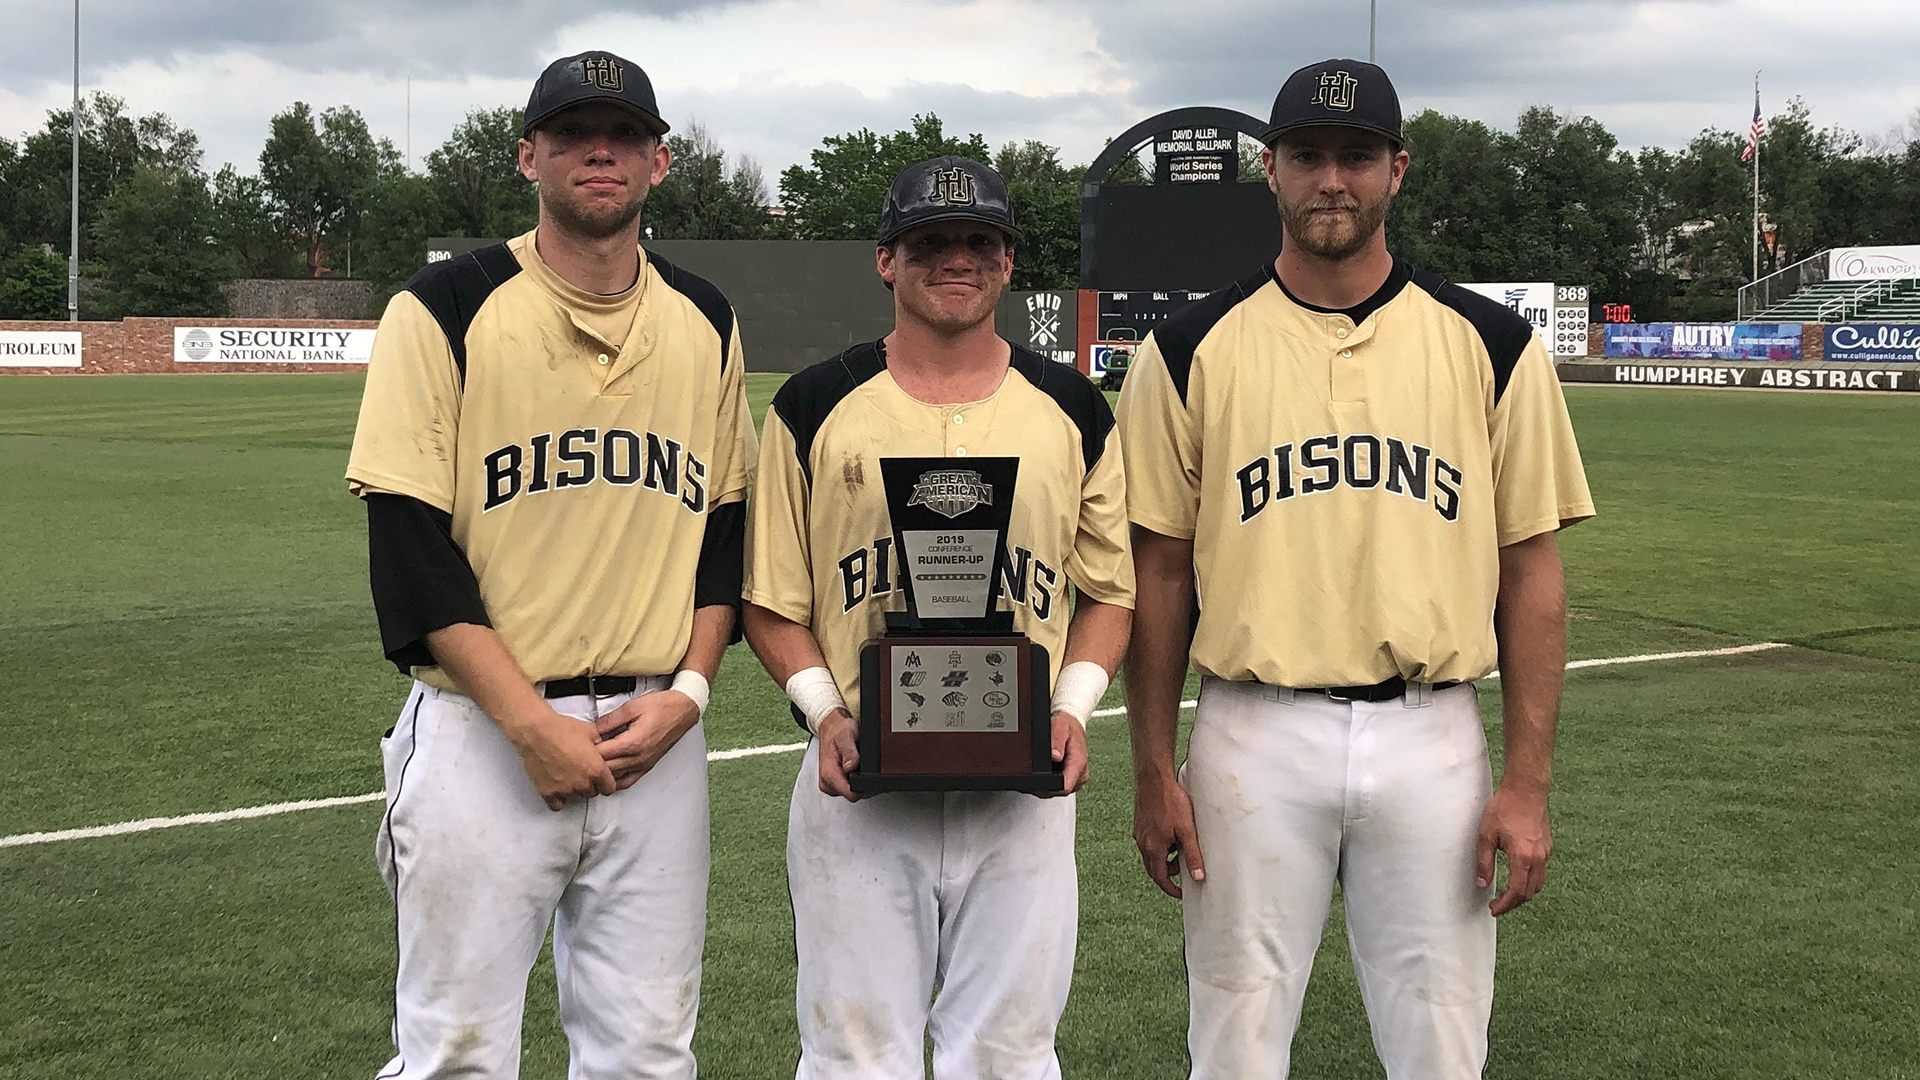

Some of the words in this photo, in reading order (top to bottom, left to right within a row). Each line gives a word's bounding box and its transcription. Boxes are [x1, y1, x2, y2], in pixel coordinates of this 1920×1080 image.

[1172, 129, 1193, 140] DAVID
[1195, 128, 1218, 139] ALLEN
[1157, 141, 1194, 153] MEMORIAL
[1196, 139, 1233, 151] BALLPARK
[1169, 162, 1190, 172] World
[1192, 161, 1223, 171] Series
[1170, 171, 1220, 182] Champions
[1112, 292, 1128, 301] MPH
[1152, 292, 1169, 301] BALL
[1557, 287, 1588, 301] 369
[1025, 293, 1062, 312] ENID
[1602, 304, 1631, 323] 7:00
[219, 330, 352, 348] SECURITY
[1672, 325, 1736, 347] AUTRY
[219, 349, 297, 361] NATIONAL
[303, 350, 346, 361] BANK
[1051, 350, 1076, 364] CAMP
[1831, 352, 1914, 361] www.culliganenid.com
[1615, 366, 1747, 386] HUMPHREY
[1759, 369, 1904, 389] ABSTRACT
[482, 426, 708, 516] BISONS
[929, 472, 971, 485] GREAT
[1235, 433, 1463, 527] BISONS
[906, 483, 994, 507] AMERICAN
[936, 535, 965, 545] 2019
[918, 555, 984, 565] RUNNER-UP
[837, 534, 1058, 623] BINS
[931, 595, 971, 604] BASEBALL
